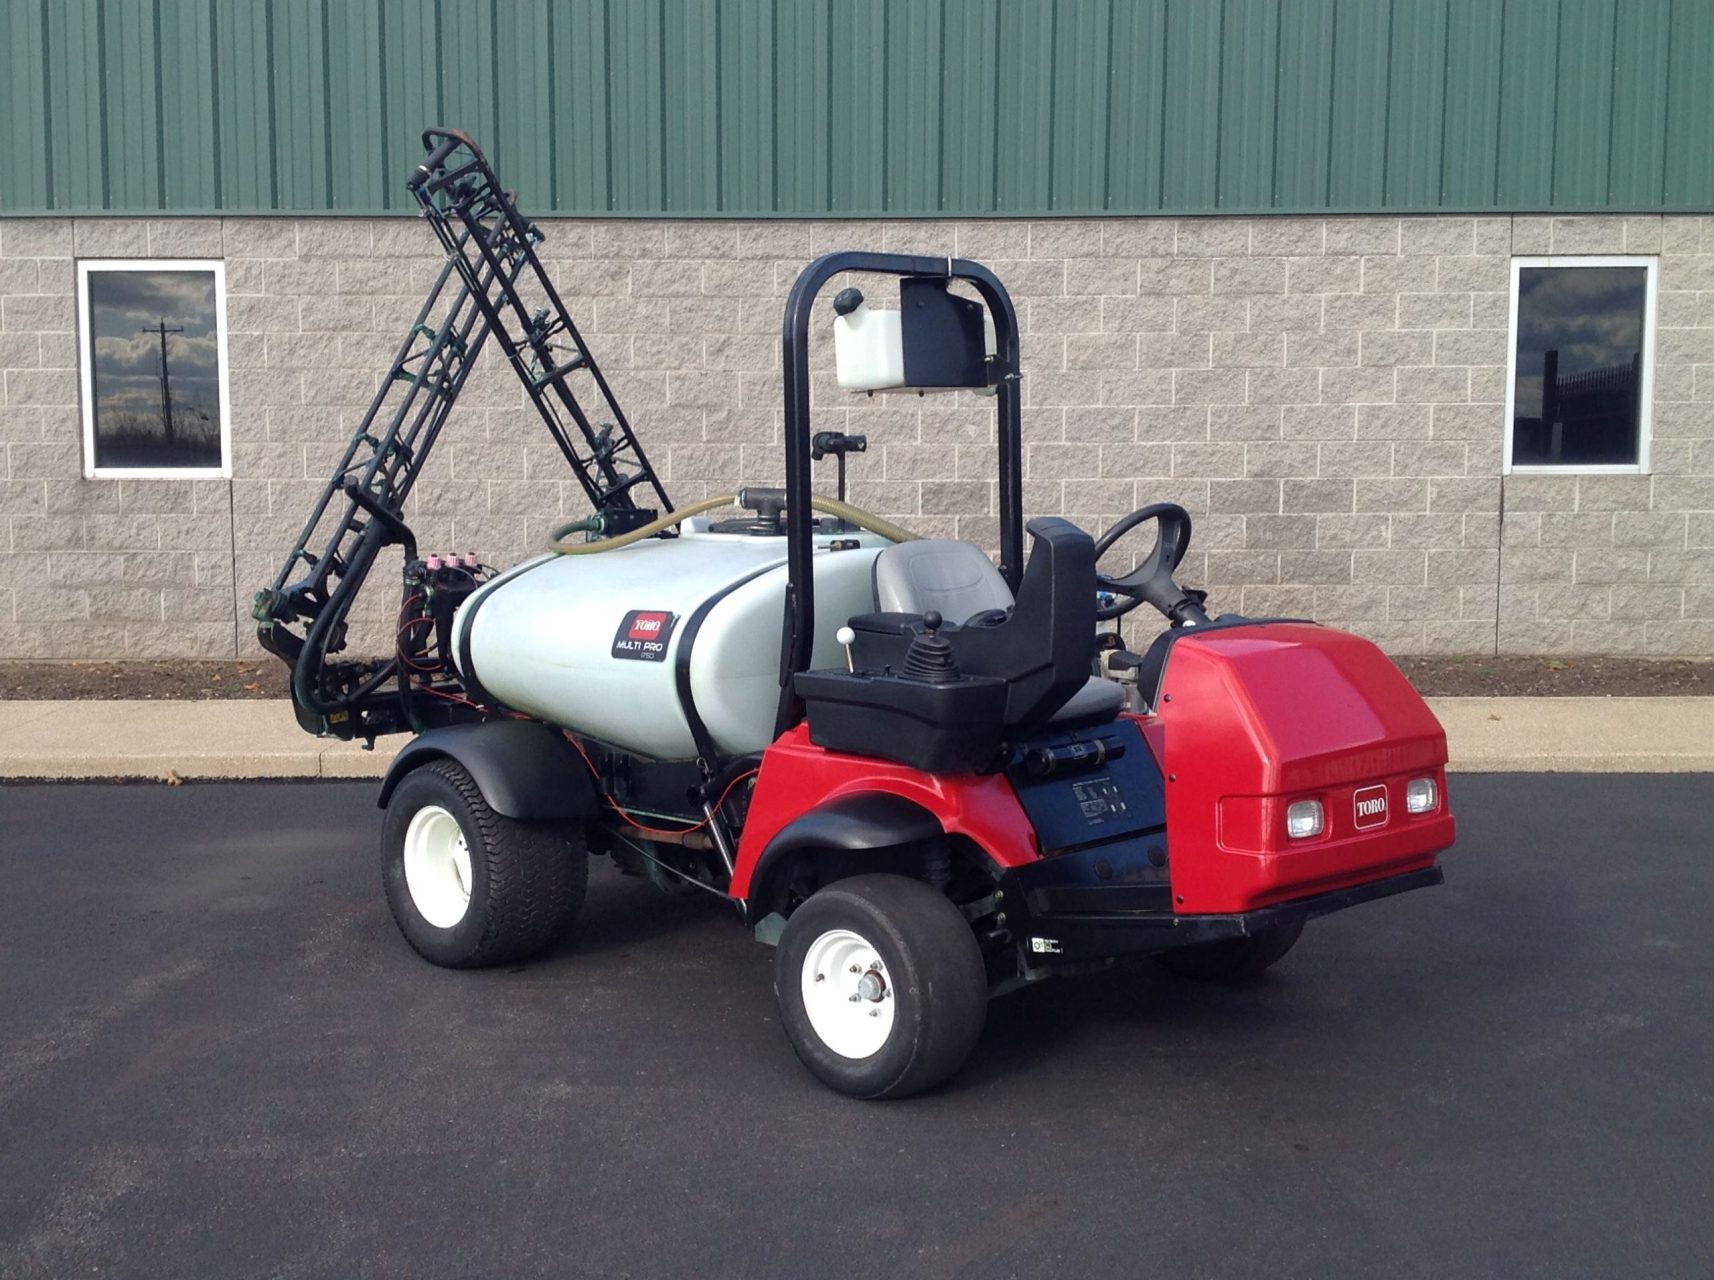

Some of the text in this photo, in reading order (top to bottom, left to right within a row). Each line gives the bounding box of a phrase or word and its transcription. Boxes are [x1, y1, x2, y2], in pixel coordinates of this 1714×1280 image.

[635, 619, 661, 631] TORO
[616, 640, 663, 652] MULTI PRO
[1356, 797, 1385, 817] TORO
